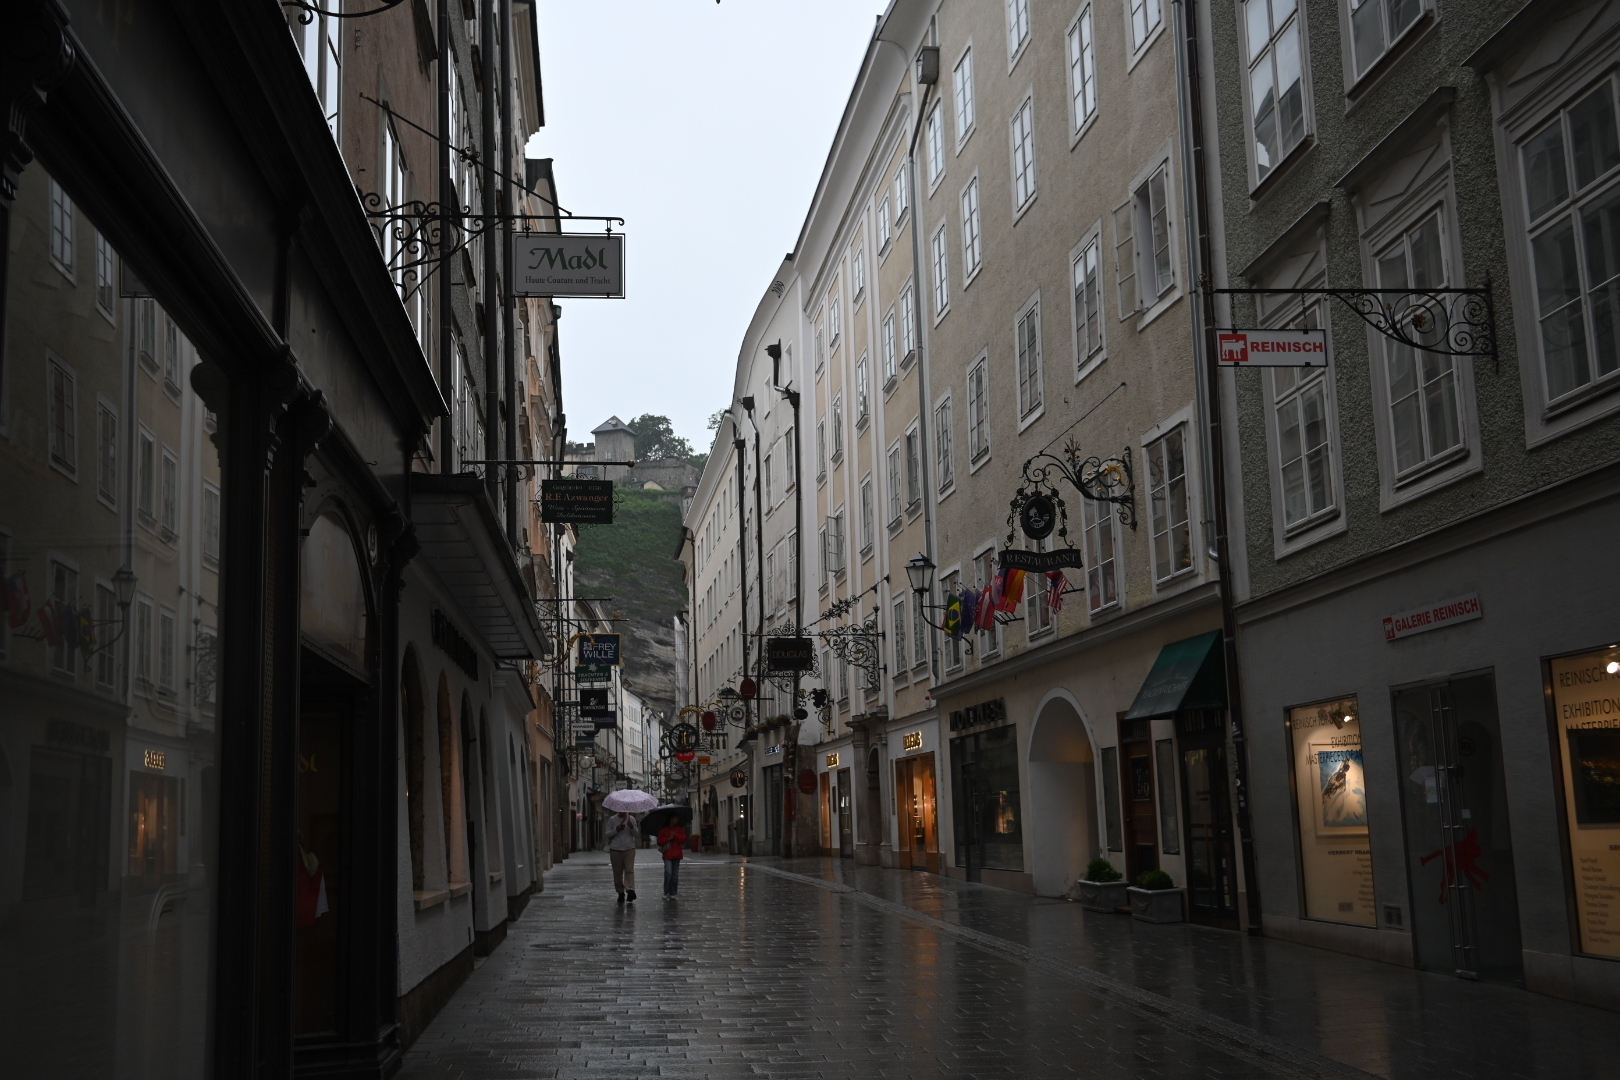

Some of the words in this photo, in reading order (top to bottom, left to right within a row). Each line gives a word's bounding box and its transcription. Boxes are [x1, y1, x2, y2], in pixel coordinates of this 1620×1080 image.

[527, 244, 608, 270] Madl
[525, 276, 545, 284] Haute
[547, 276, 573, 284] Couture
[575, 276, 588, 284] und
[589, 276, 611, 284] Tracht
[1250, 341, 1323, 353] REINISCH
[564, 493, 609, 503] Azwanger
[1006, 553, 1077, 566] RESTAURANT
[1394, 611, 1432, 632] GALERIE
[1432, 598, 1479, 622] REINISCH
[592, 642, 617, 651] FREY
[583, 651, 614, 659] WILLE
[772, 651, 808, 659] DOUGLAS
[1560, 665, 1607, 687] REINISCH
[1562, 697, 1620, 719] EXHIBITION
[1292, 716, 1317, 731] REINISCH
[1306, 750, 1345, 766] MASTERPIECES
